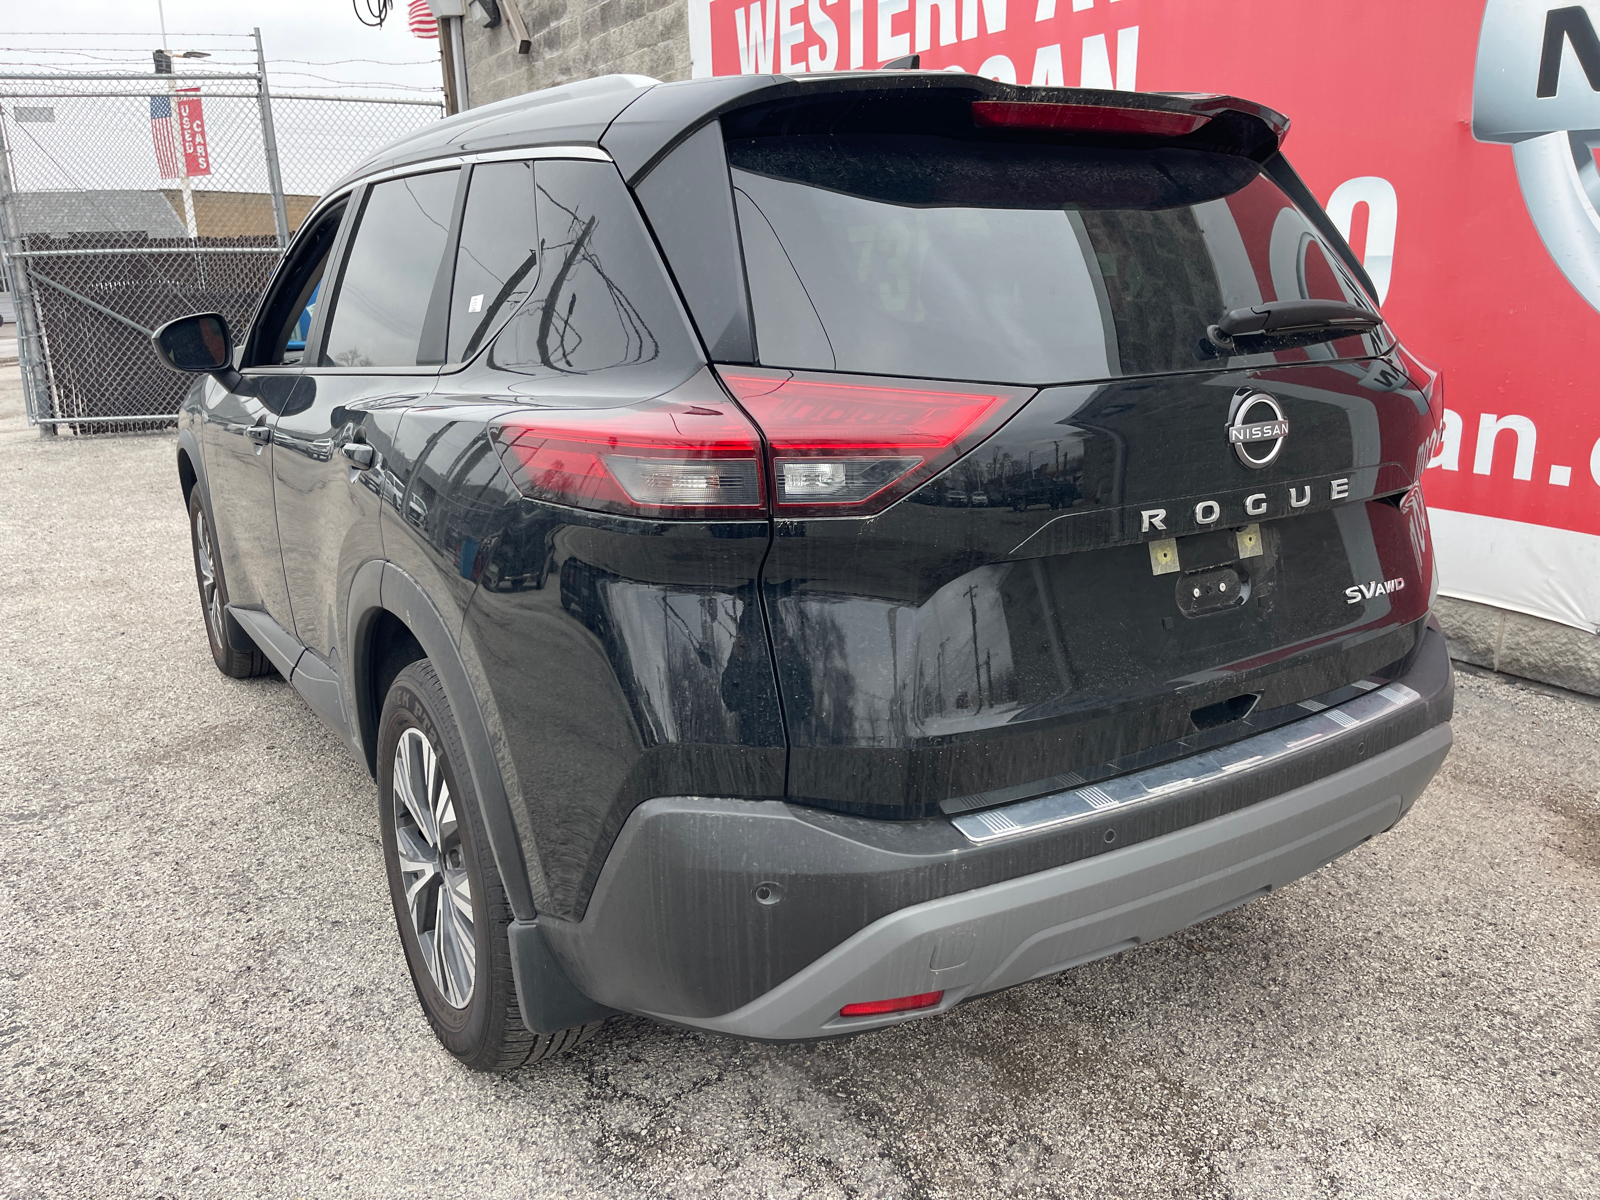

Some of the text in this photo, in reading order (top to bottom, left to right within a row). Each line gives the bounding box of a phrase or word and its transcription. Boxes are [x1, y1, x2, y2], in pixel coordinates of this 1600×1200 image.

[181, 105, 193, 154] USED
[193, 120, 207, 169] CARS
[1232, 423, 1289, 441] NISSAN
[1140, 478, 1349, 533] ROGUE
